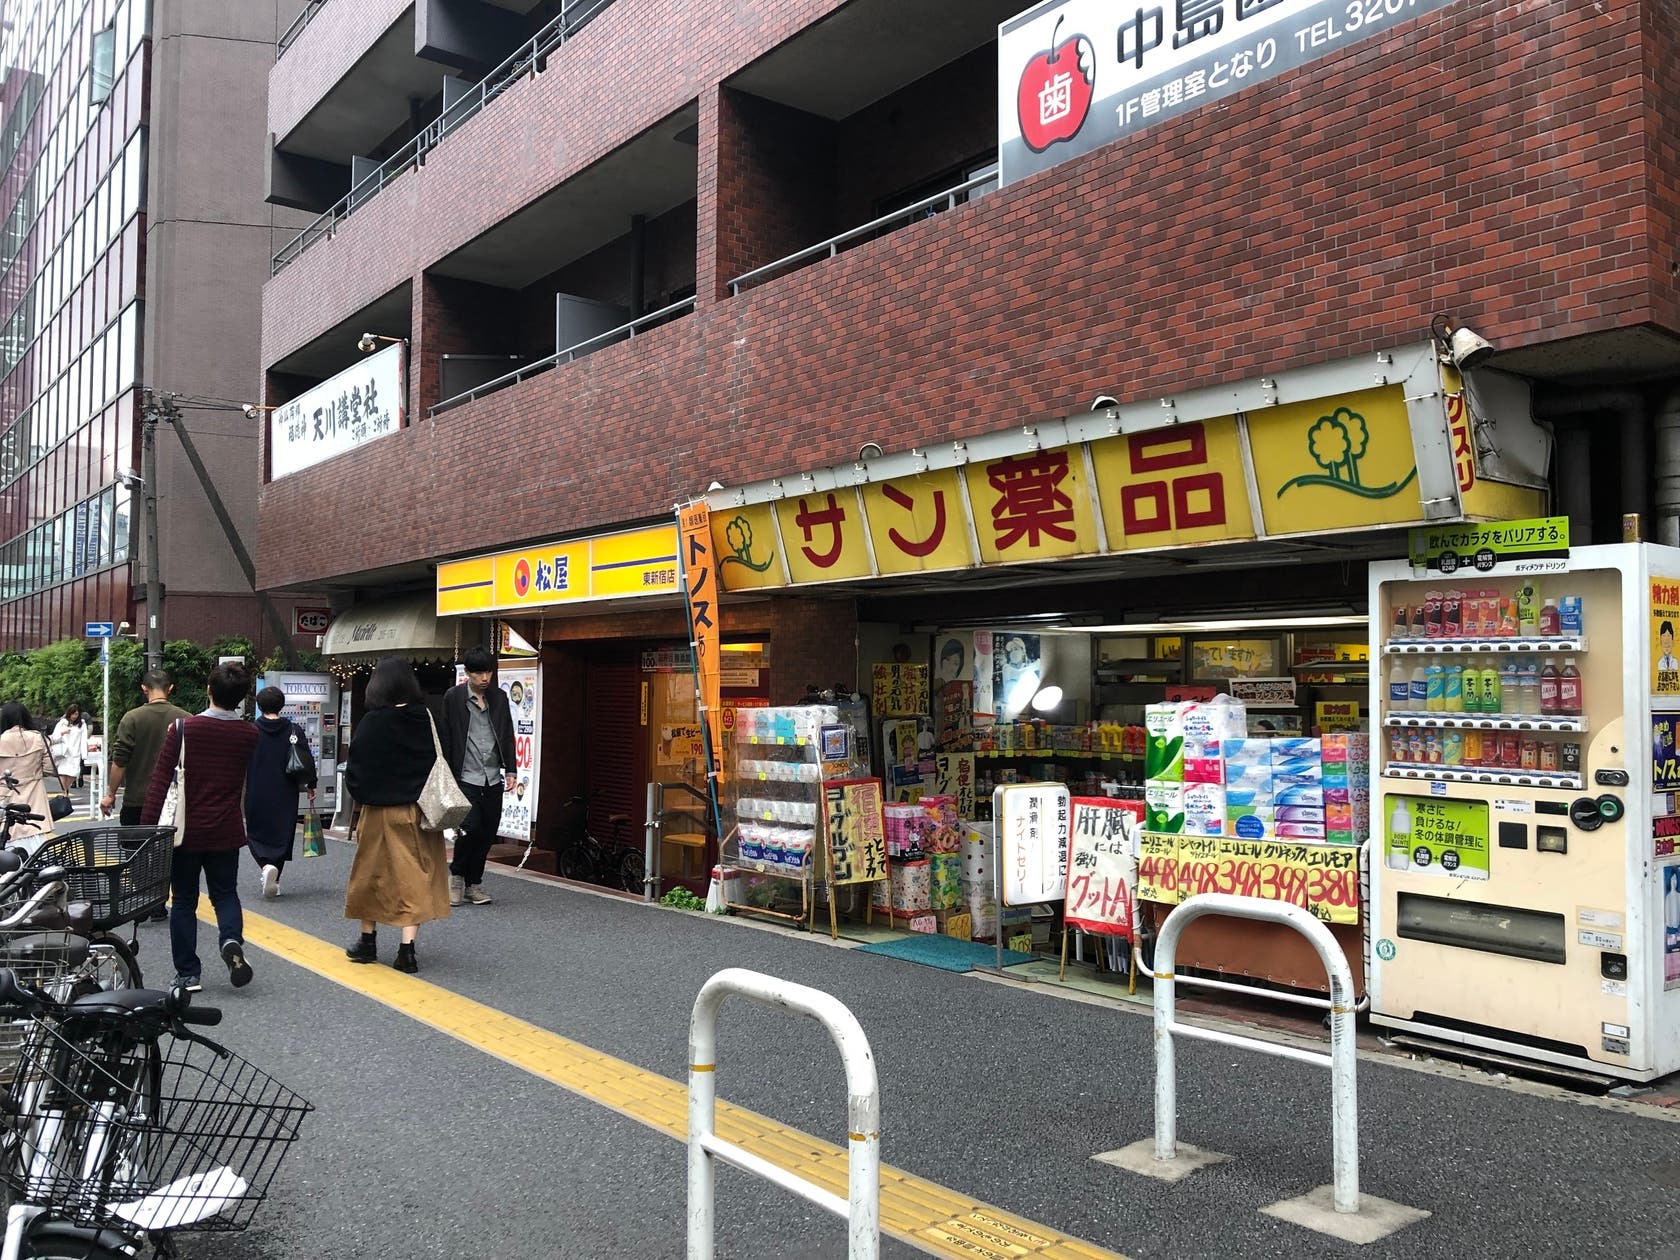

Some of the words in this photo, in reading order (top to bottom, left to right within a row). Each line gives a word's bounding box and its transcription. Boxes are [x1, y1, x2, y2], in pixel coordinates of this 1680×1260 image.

[1115, 37, 1277, 128] 1F管理室となり
[1294, 17, 1343, 54] TEL
[1037, 68, 1074, 126] 歯
[1447, 395, 1475, 493] クスリ
[795, 424, 1225, 568] サン薬品
[535, 555, 569, 592] 松屋
[642, 567, 676, 587] 東新宿店
[300, 615, 327, 627] たばこ
[285, 683, 327, 695] TOBACCO
[852, 784, 881, 842] 宿便
[1416, 802, 1445, 816] 寒さに
[873, 838, 886, 874] とって
[1094, 841, 1123, 855] には
[1141, 836, 1174, 848] エリエール
[1221, 842, 1262, 857] エリエール
[1263, 844, 1309, 864] クリネックス
[1415, 829, 1485, 848] 冬の体調管理に
[864, 842, 878, 879] オナカ
[1138, 856, 1178, 891] 498
[1307, 851, 1353, 870] エルモア
[1178, 862, 1220, 896] 498
[1219, 859, 1262, 899] 398
[1261, 863, 1308, 909] 398
[1308, 867, 1358, 908] 380
